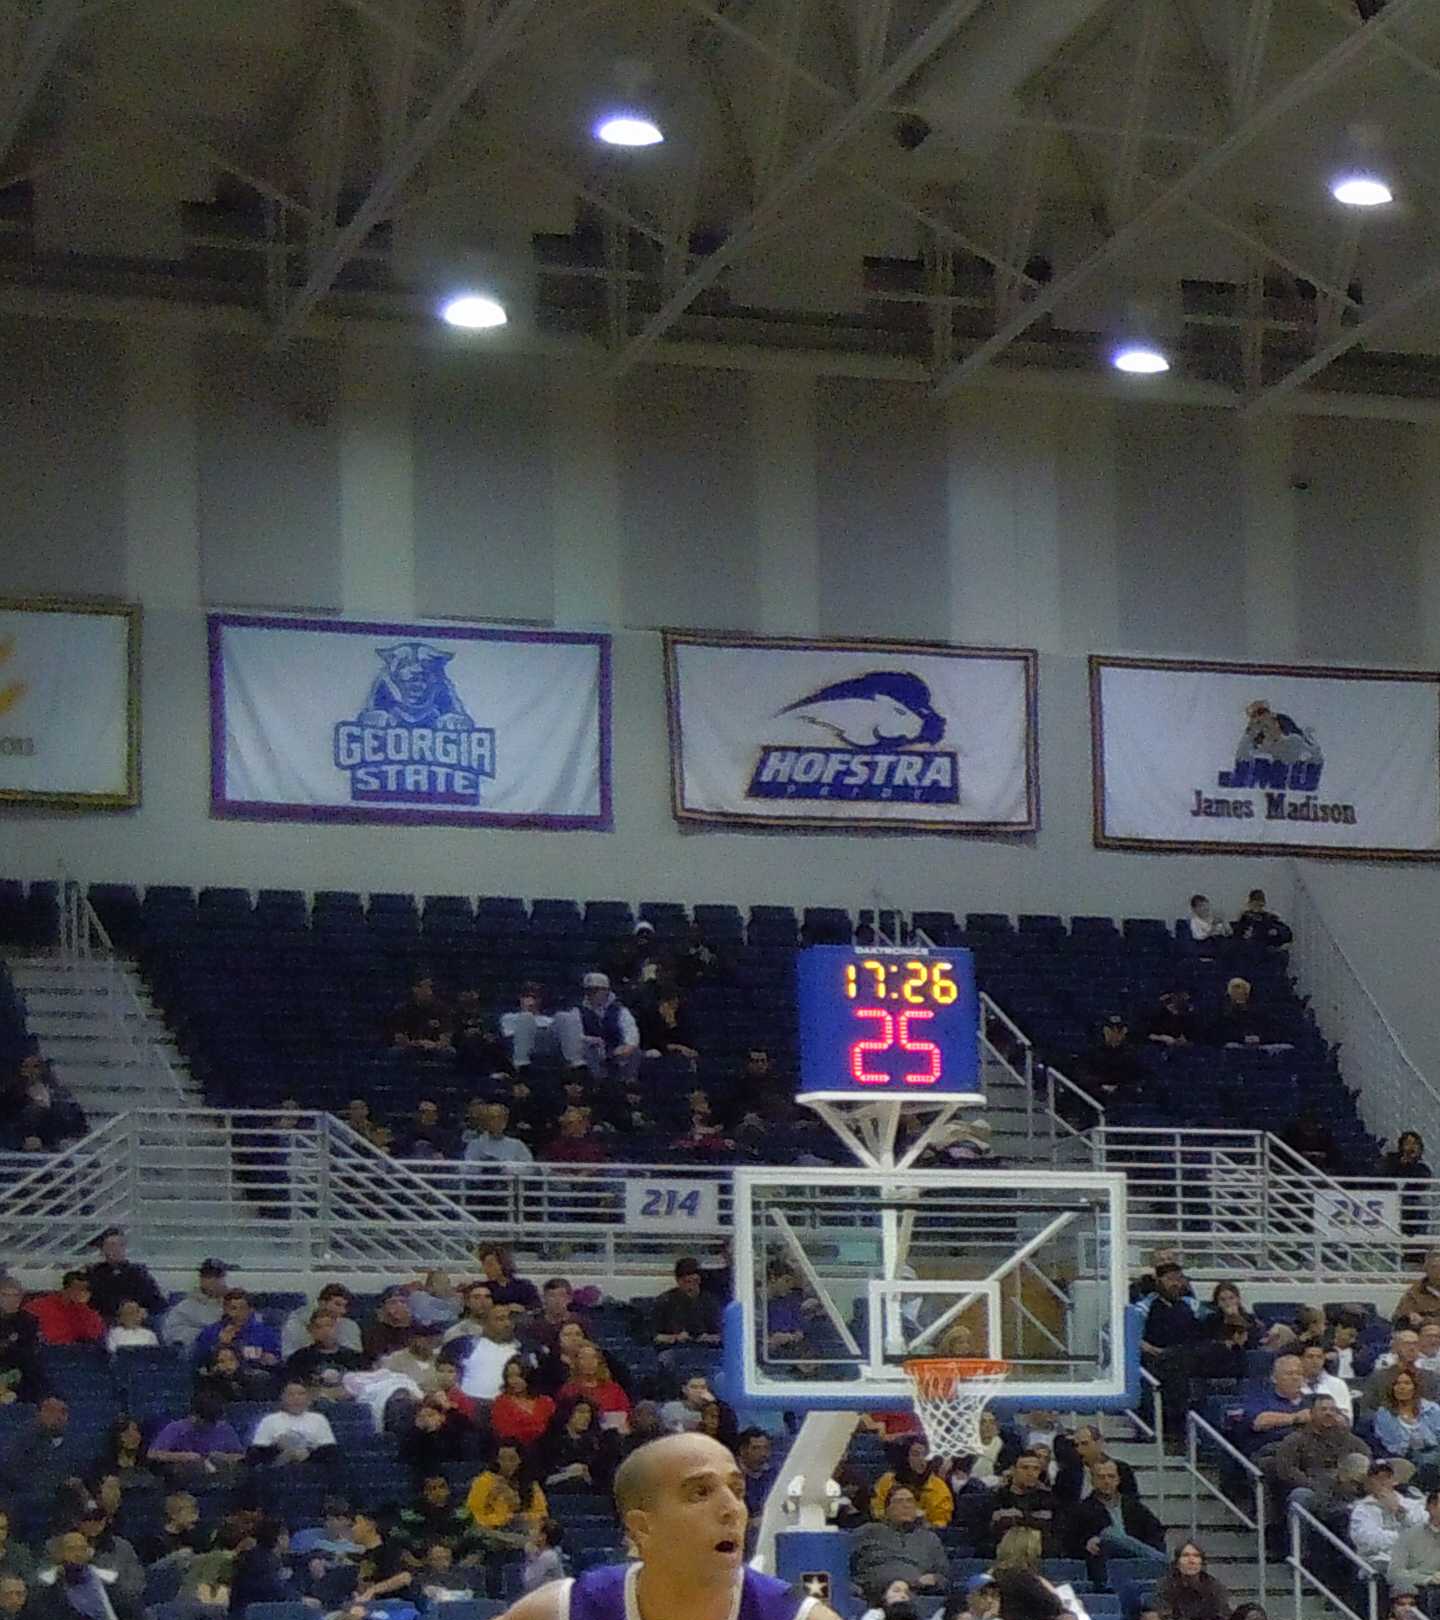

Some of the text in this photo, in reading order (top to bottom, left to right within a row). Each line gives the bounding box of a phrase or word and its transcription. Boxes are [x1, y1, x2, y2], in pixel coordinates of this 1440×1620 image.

[338, 725, 492, 774] GEORGIA
[356, 764, 477, 794] STATE
[760, 750, 951, 787] HOFSTRA
[1218, 757, 1324, 791] JMU
[1191, 790, 1358, 824] James Madison
[846, 960, 957, 1004] 17:26
[853, 1008, 941, 1084] 25
[641, 1189, 700, 1216] 214
